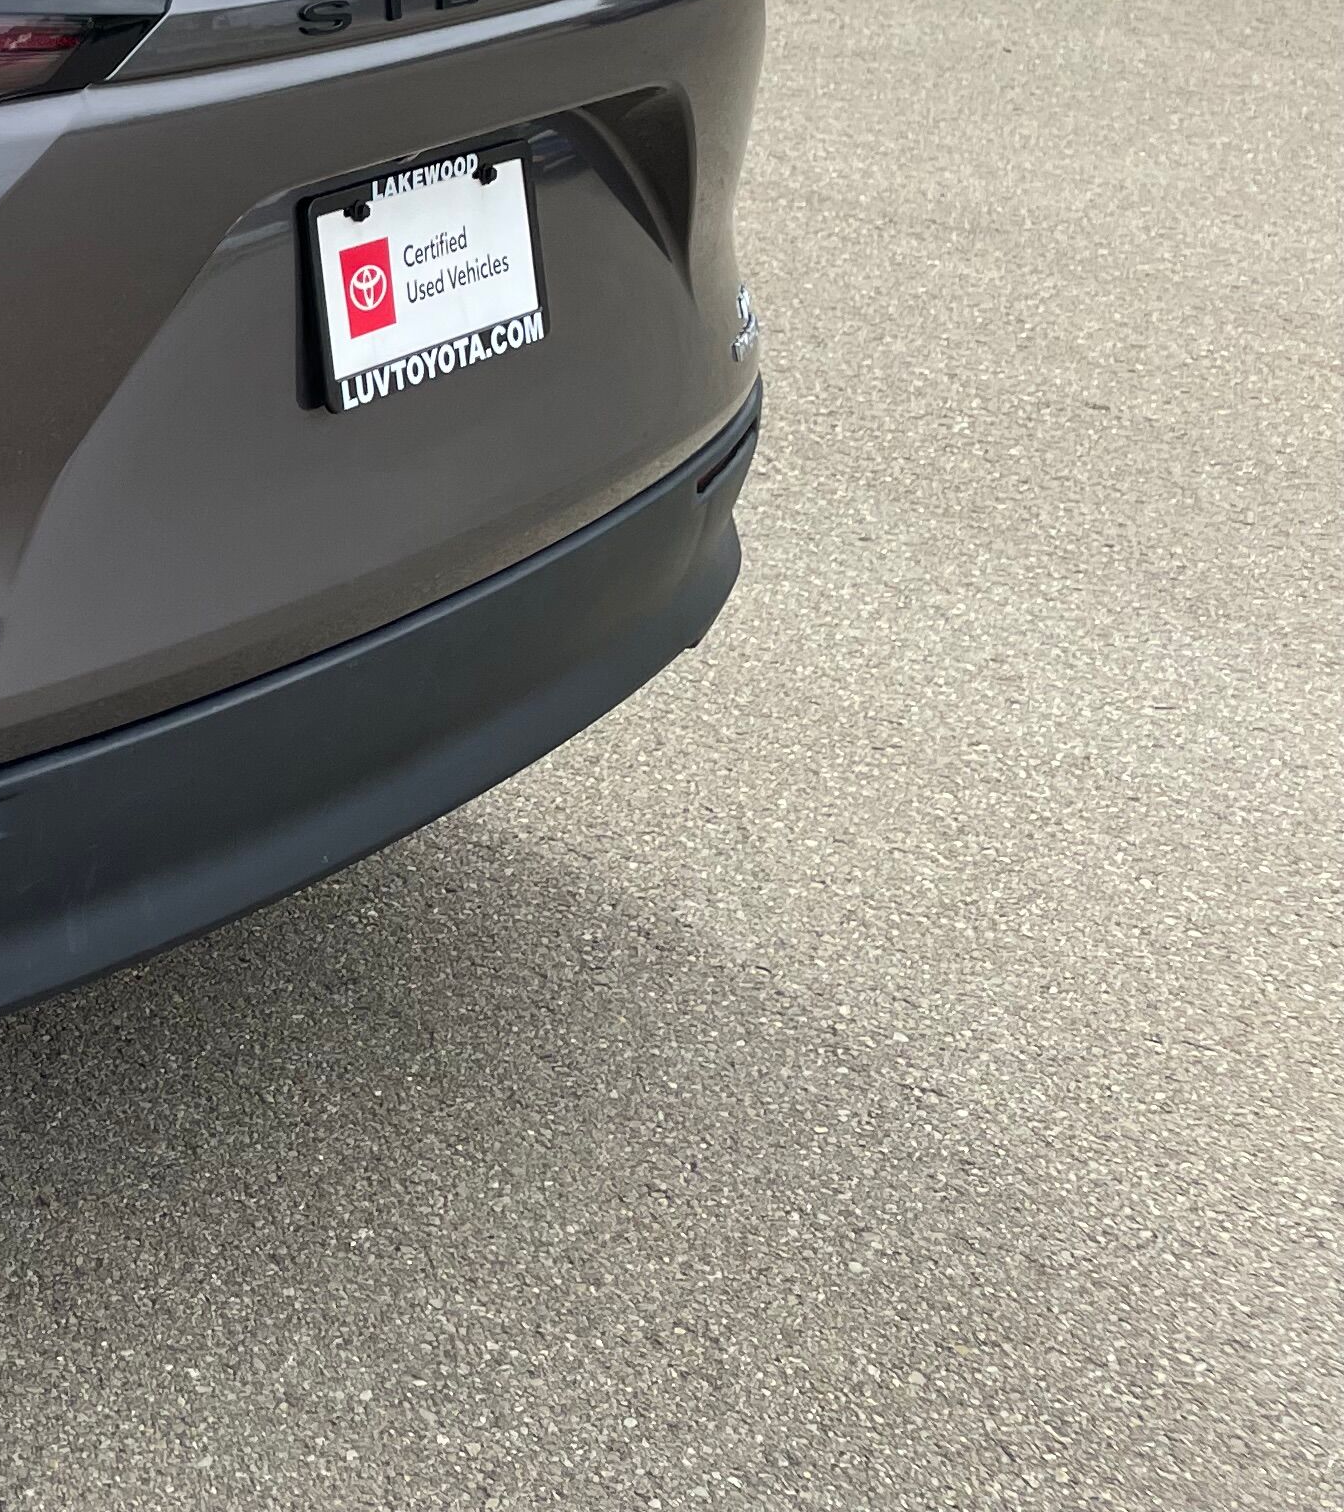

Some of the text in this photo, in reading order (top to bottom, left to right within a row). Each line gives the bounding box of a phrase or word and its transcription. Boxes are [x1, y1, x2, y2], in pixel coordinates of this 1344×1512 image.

[371, 152, 478, 201] LAKEWOOD
[403, 225, 468, 267] Certified
[407, 254, 510, 303] Used Vehicles
[341, 312, 545, 411] LUVTOYOTA.COM
